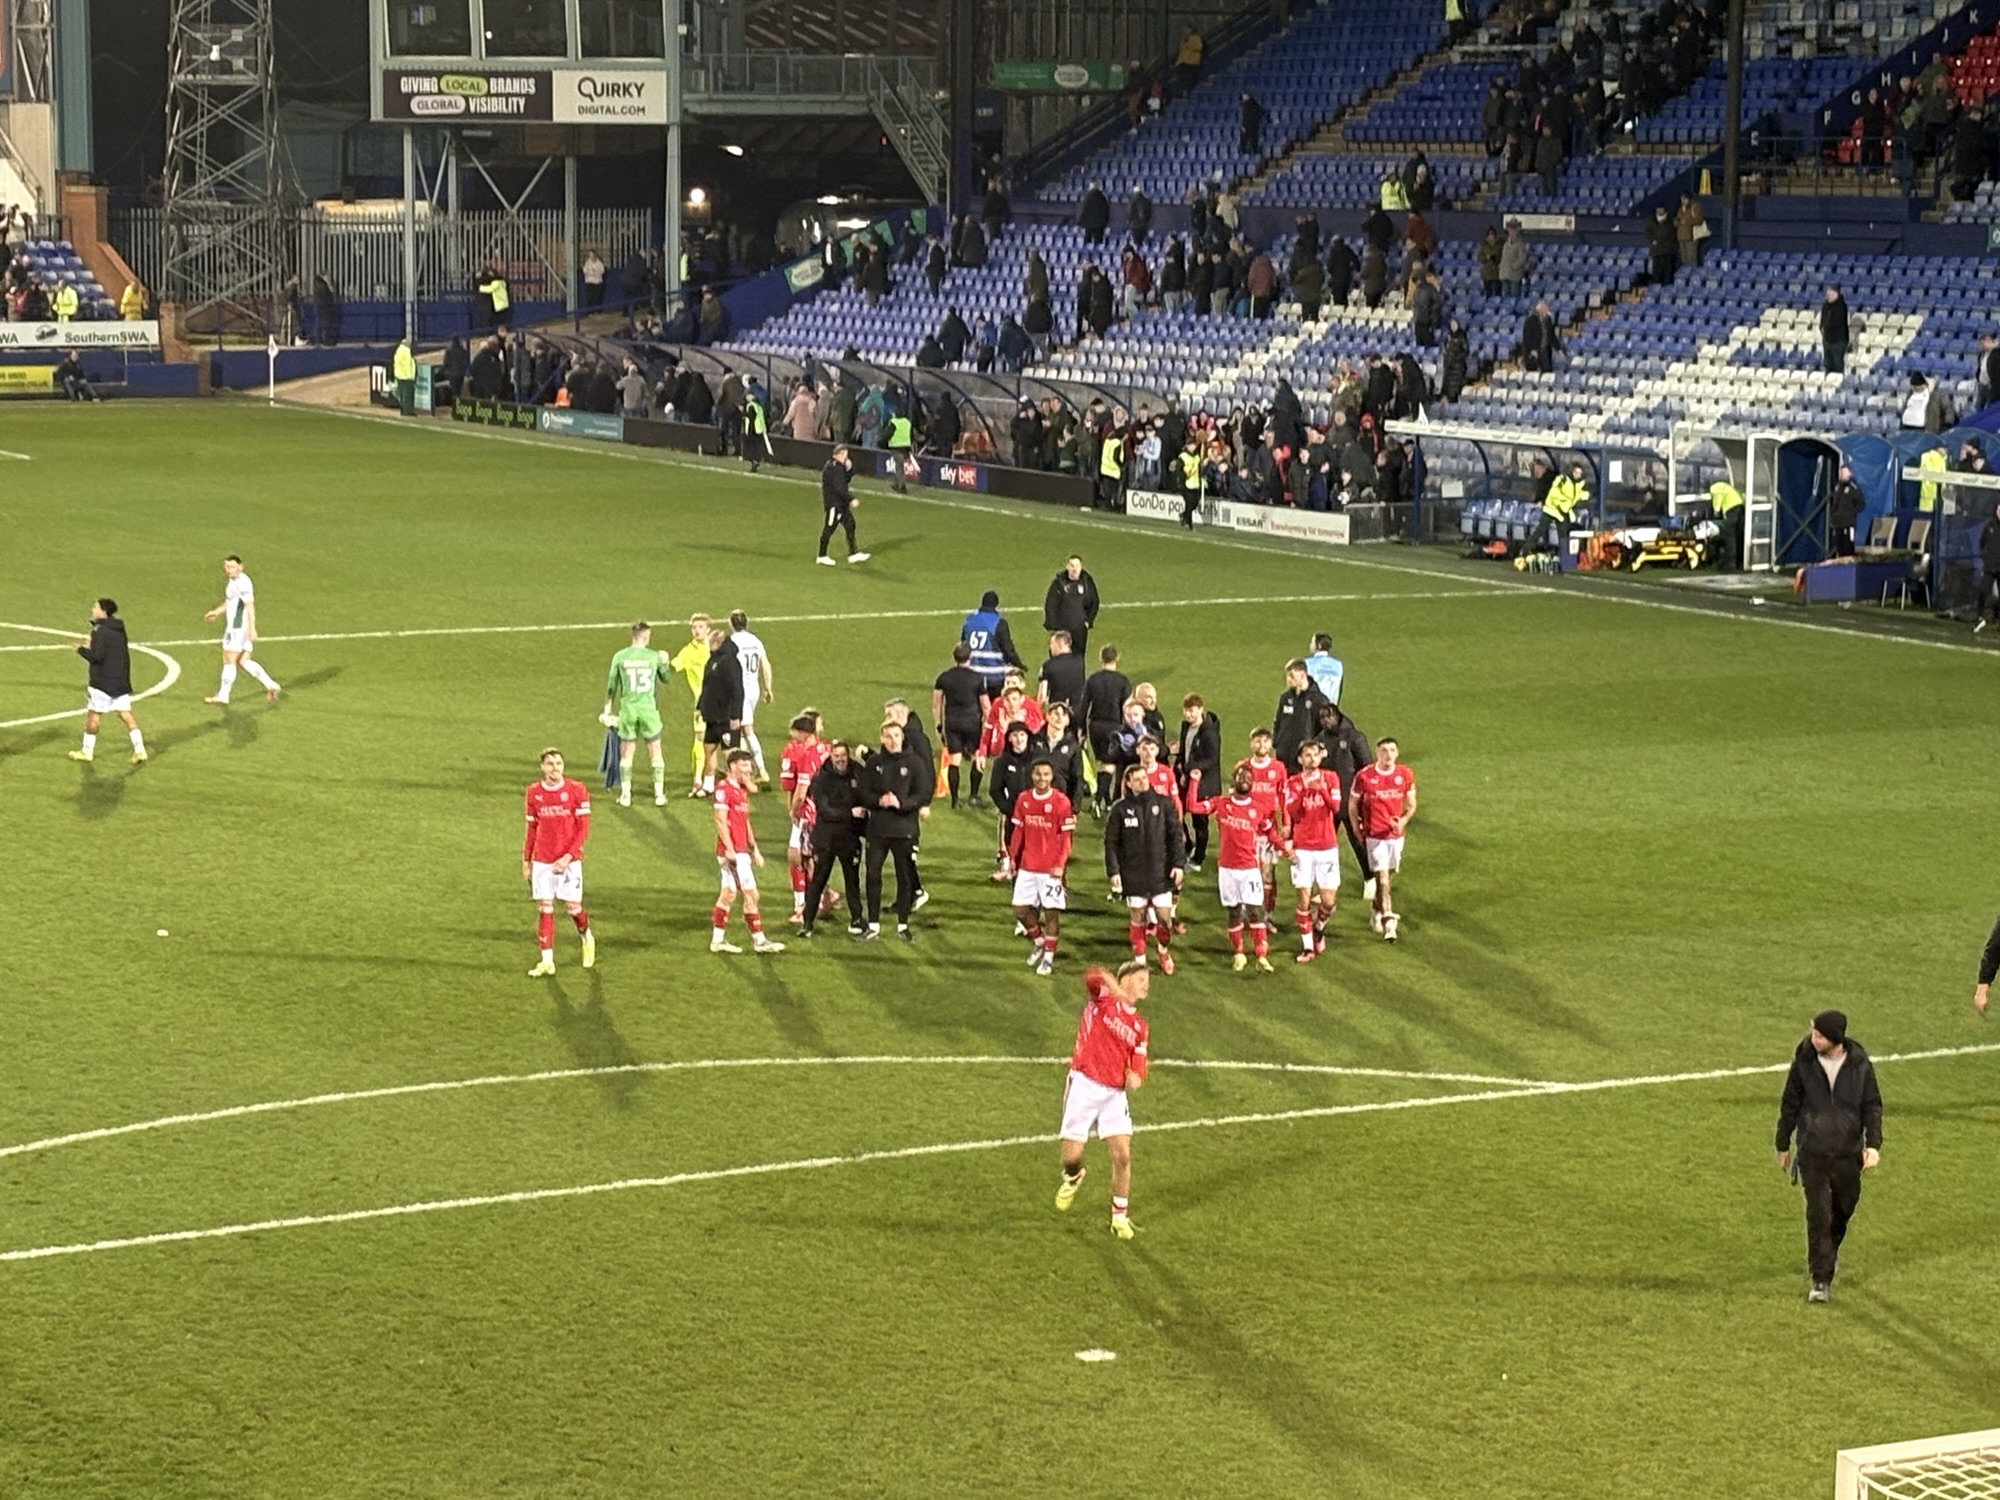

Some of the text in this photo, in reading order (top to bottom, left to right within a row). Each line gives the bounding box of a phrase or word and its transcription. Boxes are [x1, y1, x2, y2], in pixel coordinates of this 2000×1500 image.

[400, 76, 536, 95] GIVING LOCAL BRANDS
[577, 76, 645, 103] QUIRKY
[416, 97, 525, 114] GLOBAL VISIBILITY
[577, 104, 646, 117] DIGITAL.COM
[64, 330, 149, 344] SouthernSWA
[940, 464, 977, 486] sky bet
[1131, 491, 1166, 511] CanDo
[969, 630, 988, 650] 67
[744, 652, 758, 673] 10
[626, 668, 652, 692] 13
[1045, 885, 1062, 897] 29
